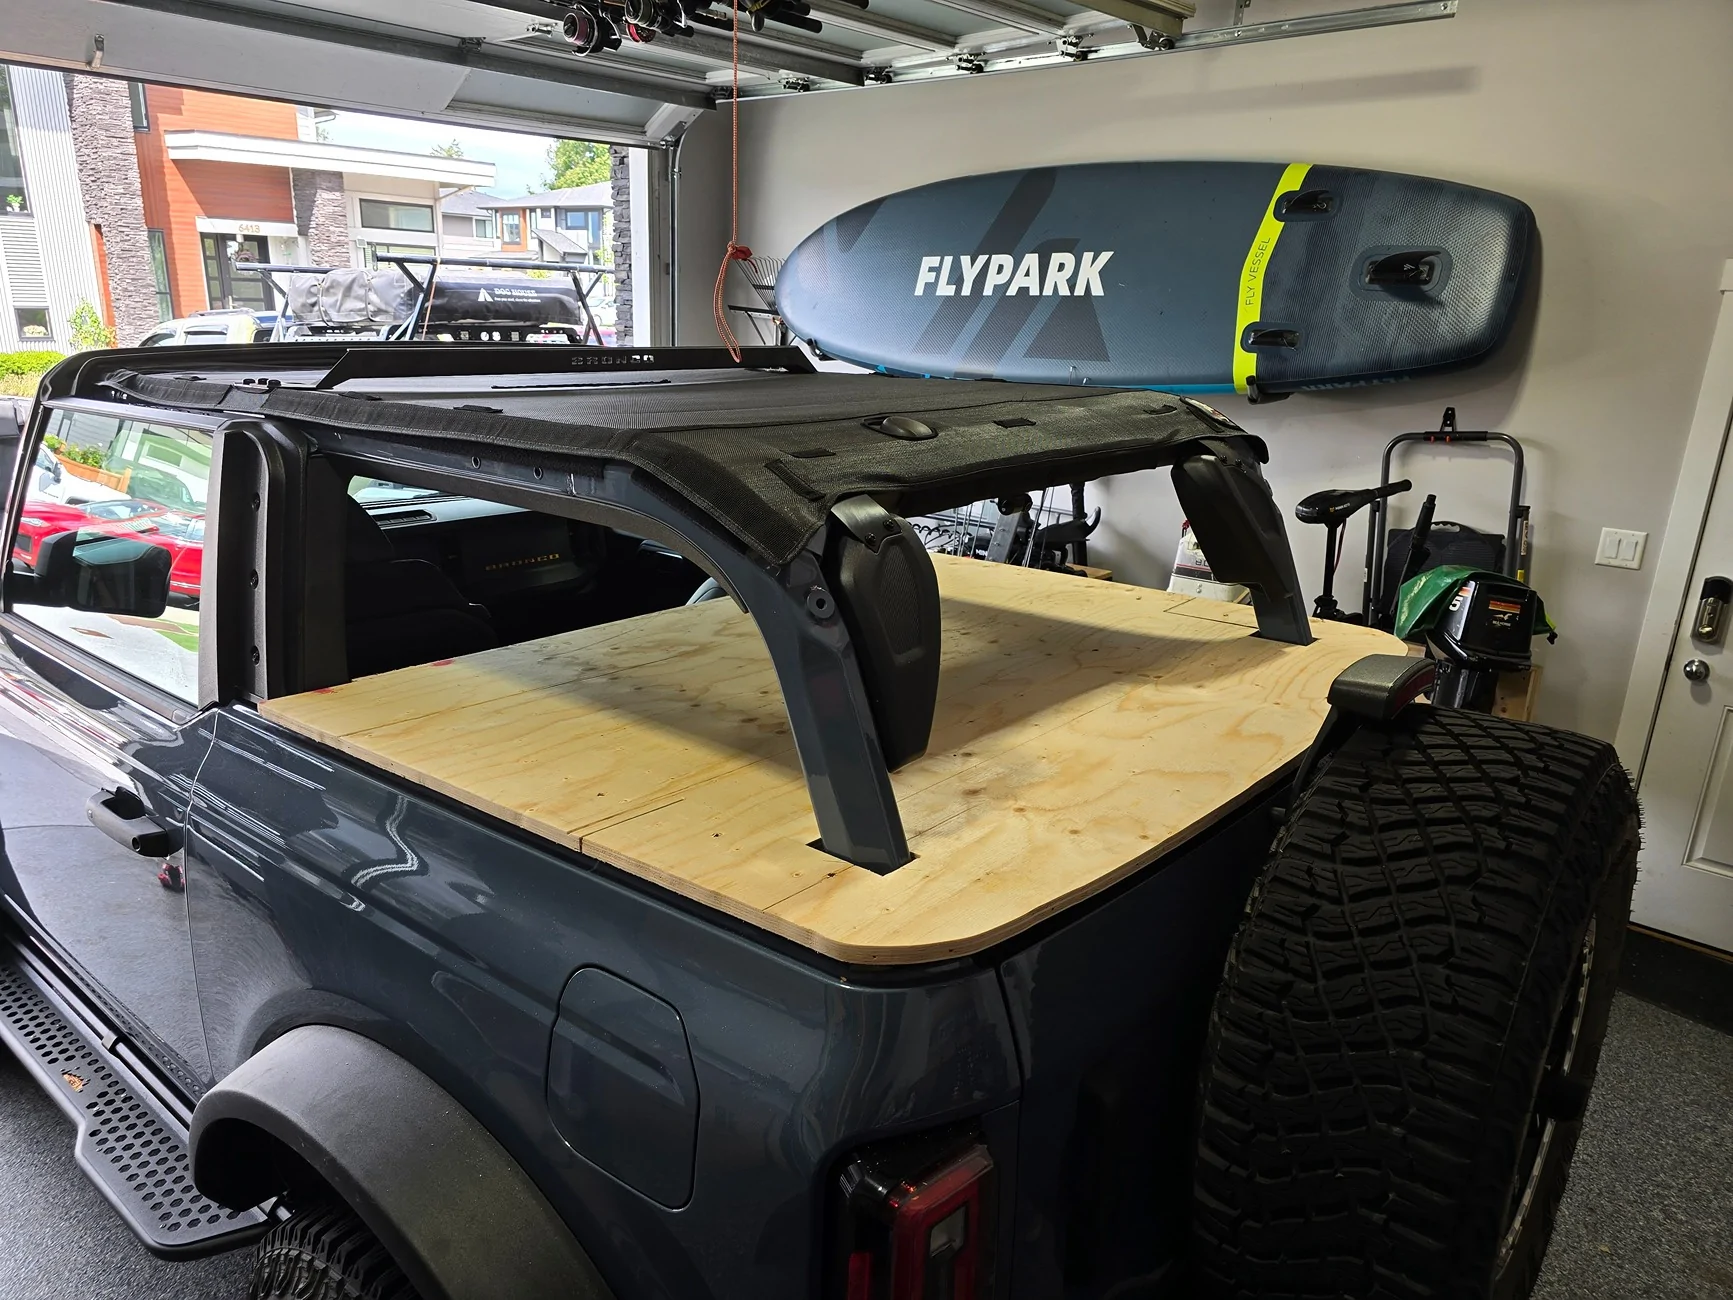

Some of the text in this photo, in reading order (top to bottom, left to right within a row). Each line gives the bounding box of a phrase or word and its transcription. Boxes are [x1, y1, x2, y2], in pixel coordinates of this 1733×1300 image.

[238, 224, 261, 233] 6413
[914, 251, 1115, 297] FLYPARK
[1245, 237, 1271, 306] FLY VESSEL
[571, 354, 655, 366] BRONCO
[485, 553, 560, 571] BRONCO
